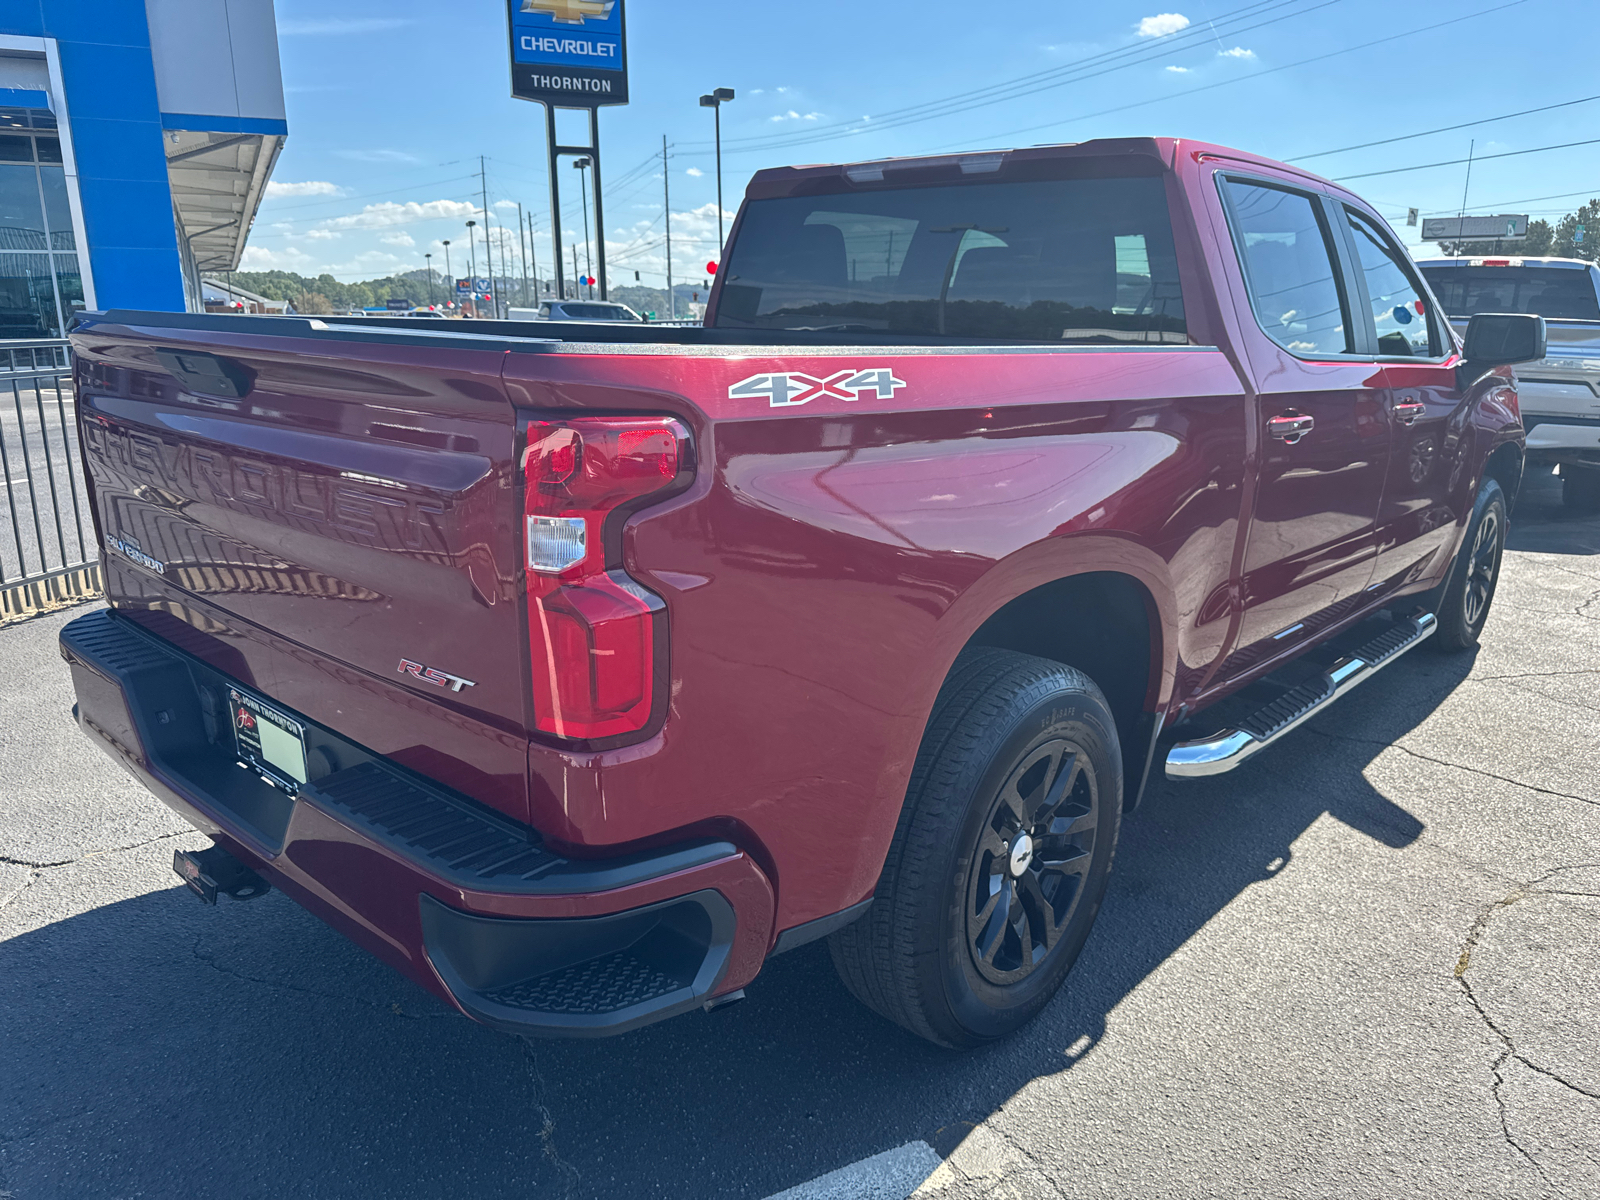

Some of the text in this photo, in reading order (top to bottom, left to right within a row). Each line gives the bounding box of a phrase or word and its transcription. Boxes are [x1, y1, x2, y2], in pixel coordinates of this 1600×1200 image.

[520, 35, 617, 57] CHEVROLET
[531, 74, 611, 93] THORNTON
[84, 414, 447, 547] CHEVROLET
[397, 658, 477, 692] RST
[242, 695, 260, 713] JOHN
[260, 705, 298, 735] THORNTON
